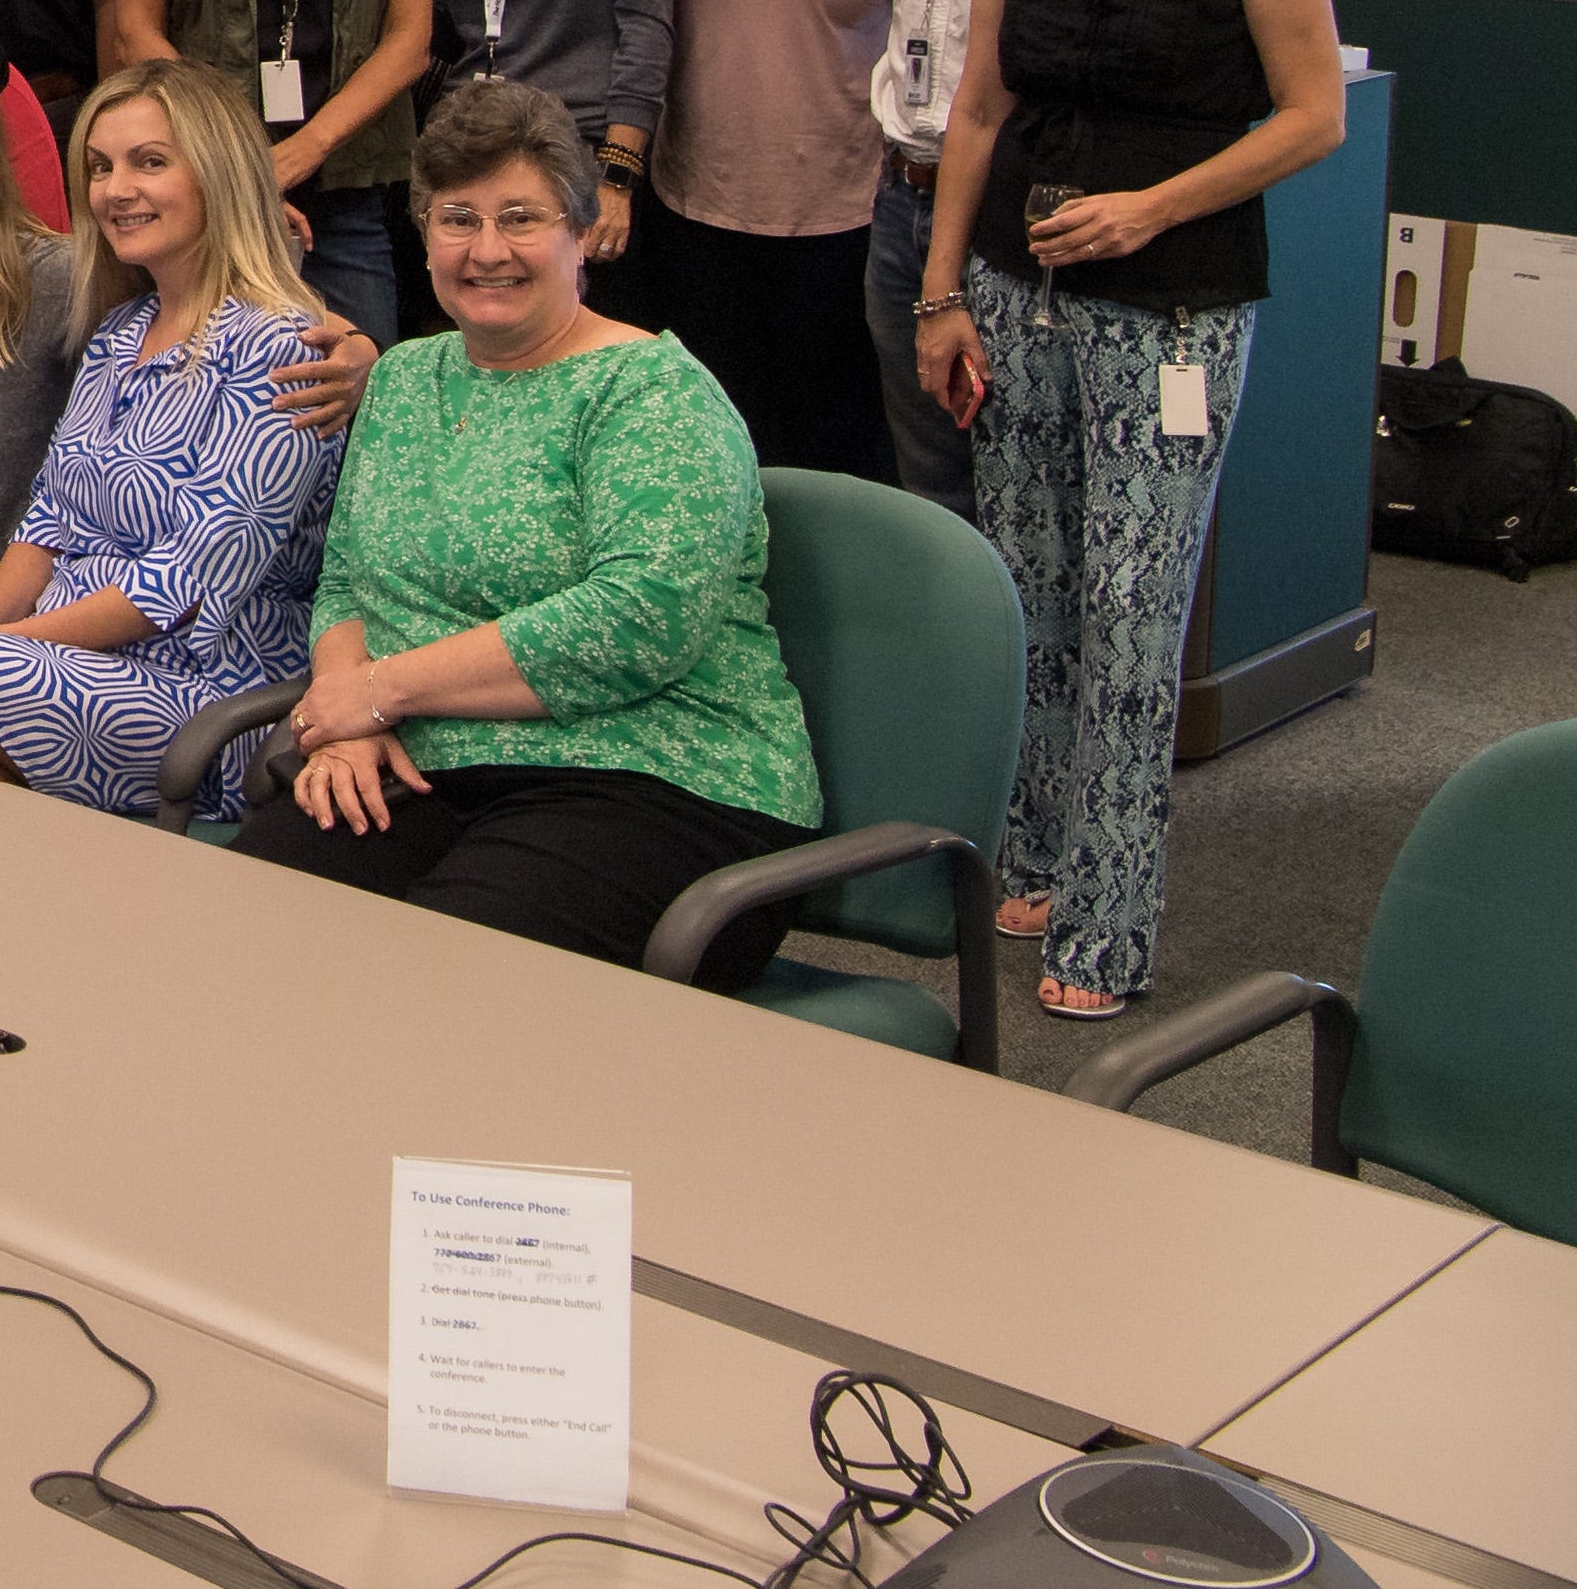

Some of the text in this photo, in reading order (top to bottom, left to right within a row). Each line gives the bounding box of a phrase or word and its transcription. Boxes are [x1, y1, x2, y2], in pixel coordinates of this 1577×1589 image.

[1399, 227, 1414, 244] B
[412, 1191, 571, 1216] To Use Conference Phone:
[434, 1230, 451, 1240] Ask
[454, 1232, 479, 1243] caller
[483, 1235, 493, 1244] to
[496, 1236, 513, 1246] dial
[432, 1284, 450, 1295] Get
[453, 1287, 470, 1297] dial
[473, 1290, 495, 1299] tone
[498, 1291, 527, 1304] (press
[530, 1295, 561, 1307] phone
[430, 1354, 453, 1365] Wait
[456, 1356, 470, 1367] for
[473, 1359, 504, 1371] callers
[507, 1362, 517, 1372] to
[520, 1364, 546, 1375] enter
[549, 1366, 566, 1377] the
[430, 1369, 487, 1384] conference.
[429, 1406, 441, 1416] To
[444, 1408, 498, 1423] disconnect,
[501, 1414, 528, 1426] press
[531, 1416, 559, 1428] either
[429, 1422, 530, 1440] or the phone button.
